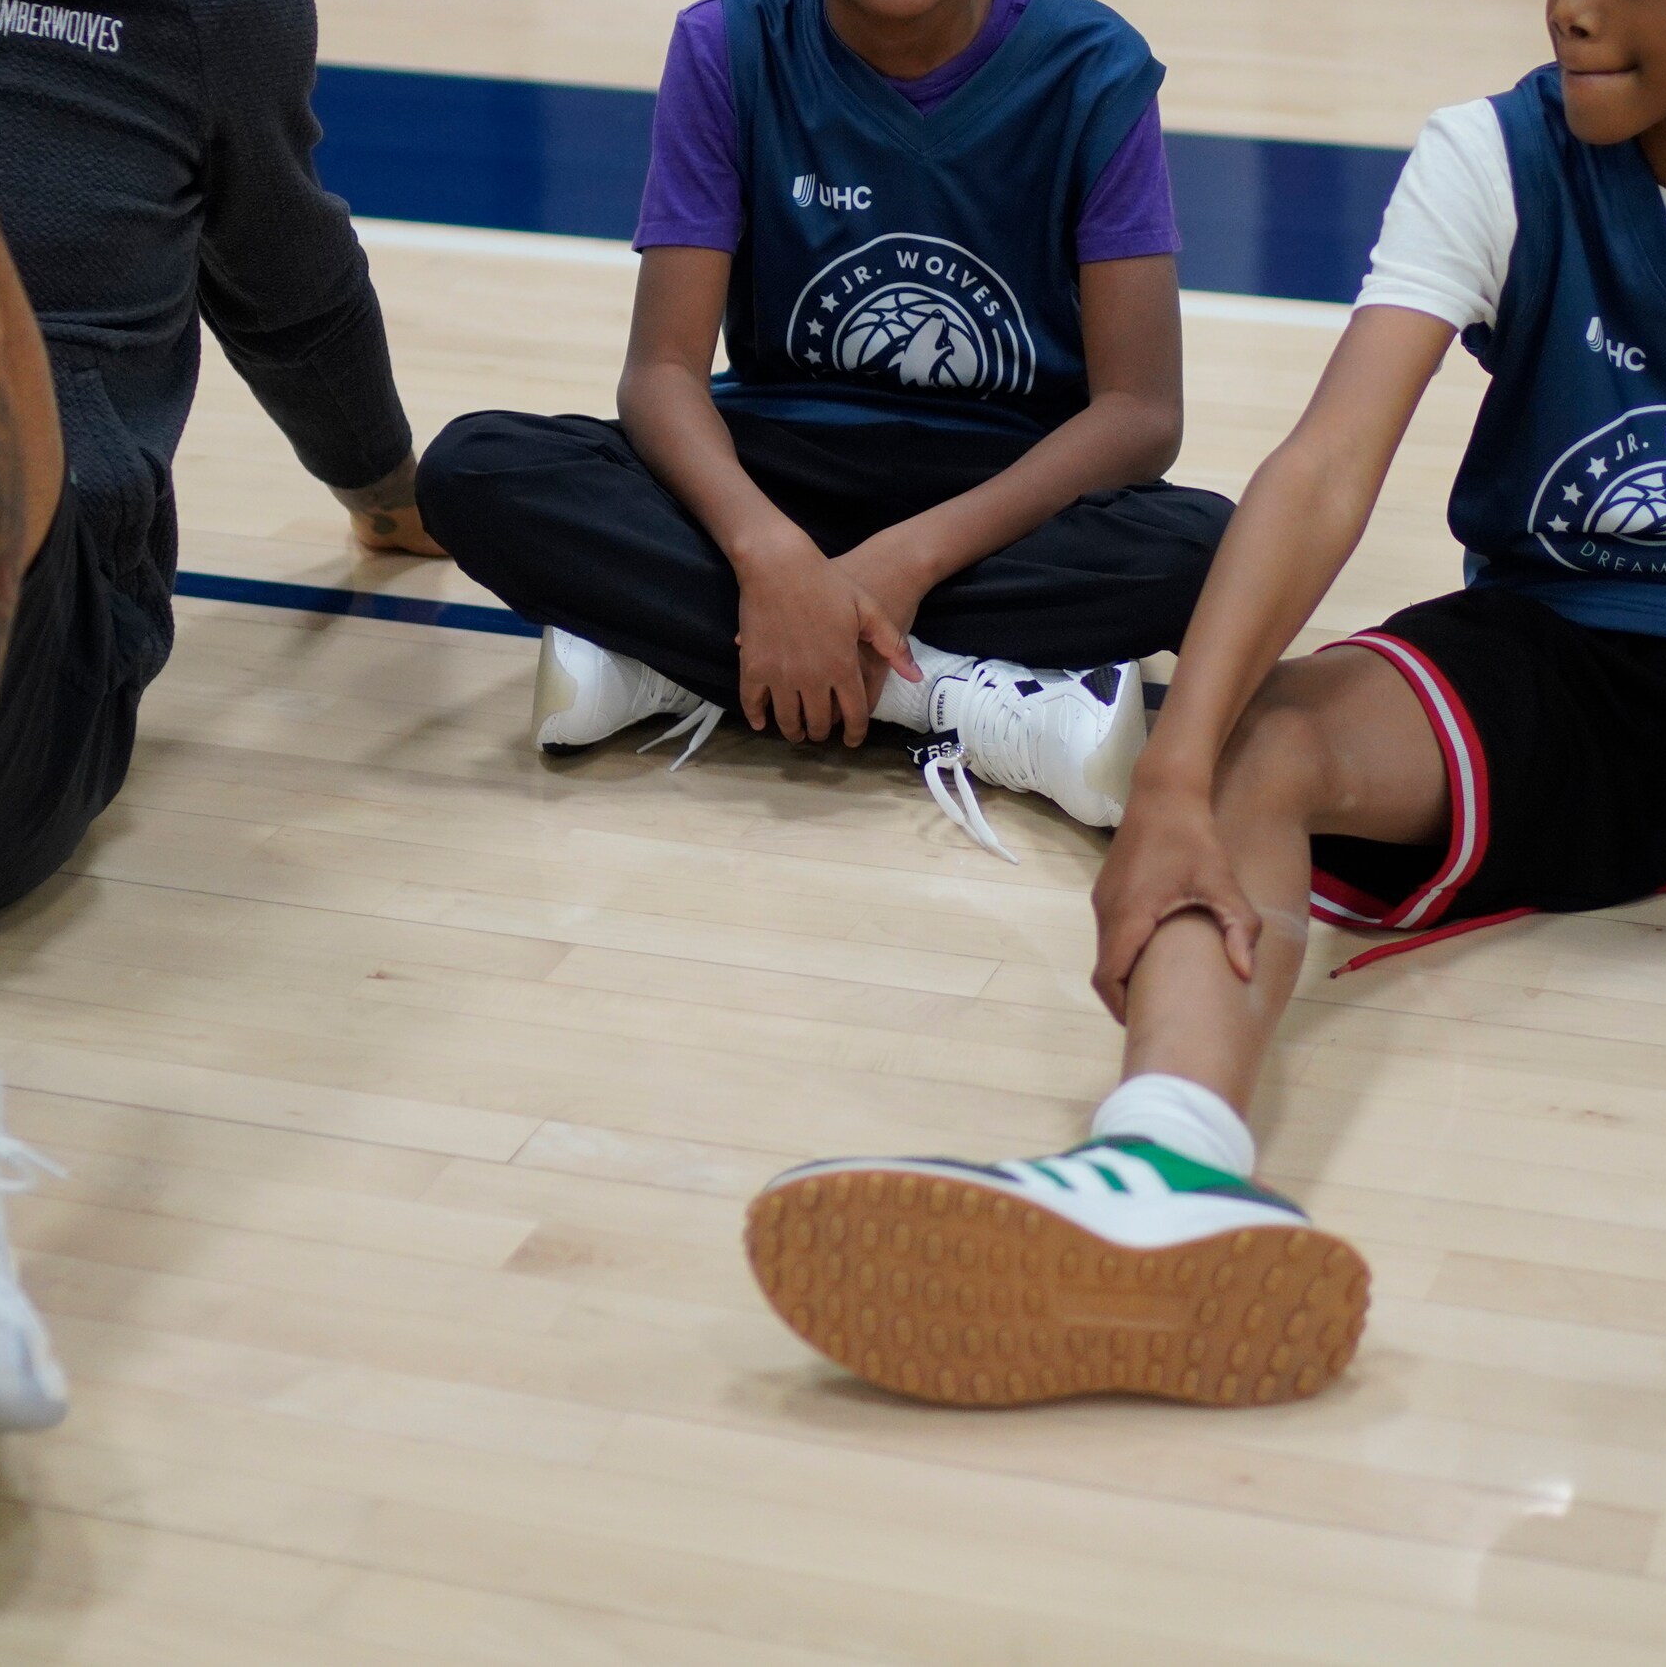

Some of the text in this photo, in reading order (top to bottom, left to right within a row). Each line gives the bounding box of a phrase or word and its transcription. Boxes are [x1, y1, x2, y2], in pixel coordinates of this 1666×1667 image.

[819, 182, 873, 211] UHC
[841, 250, 1000, 318] JR. WOLVES
[1606, 338, 1647, 372] HC
[1615, 432, 1649, 461] JR.
